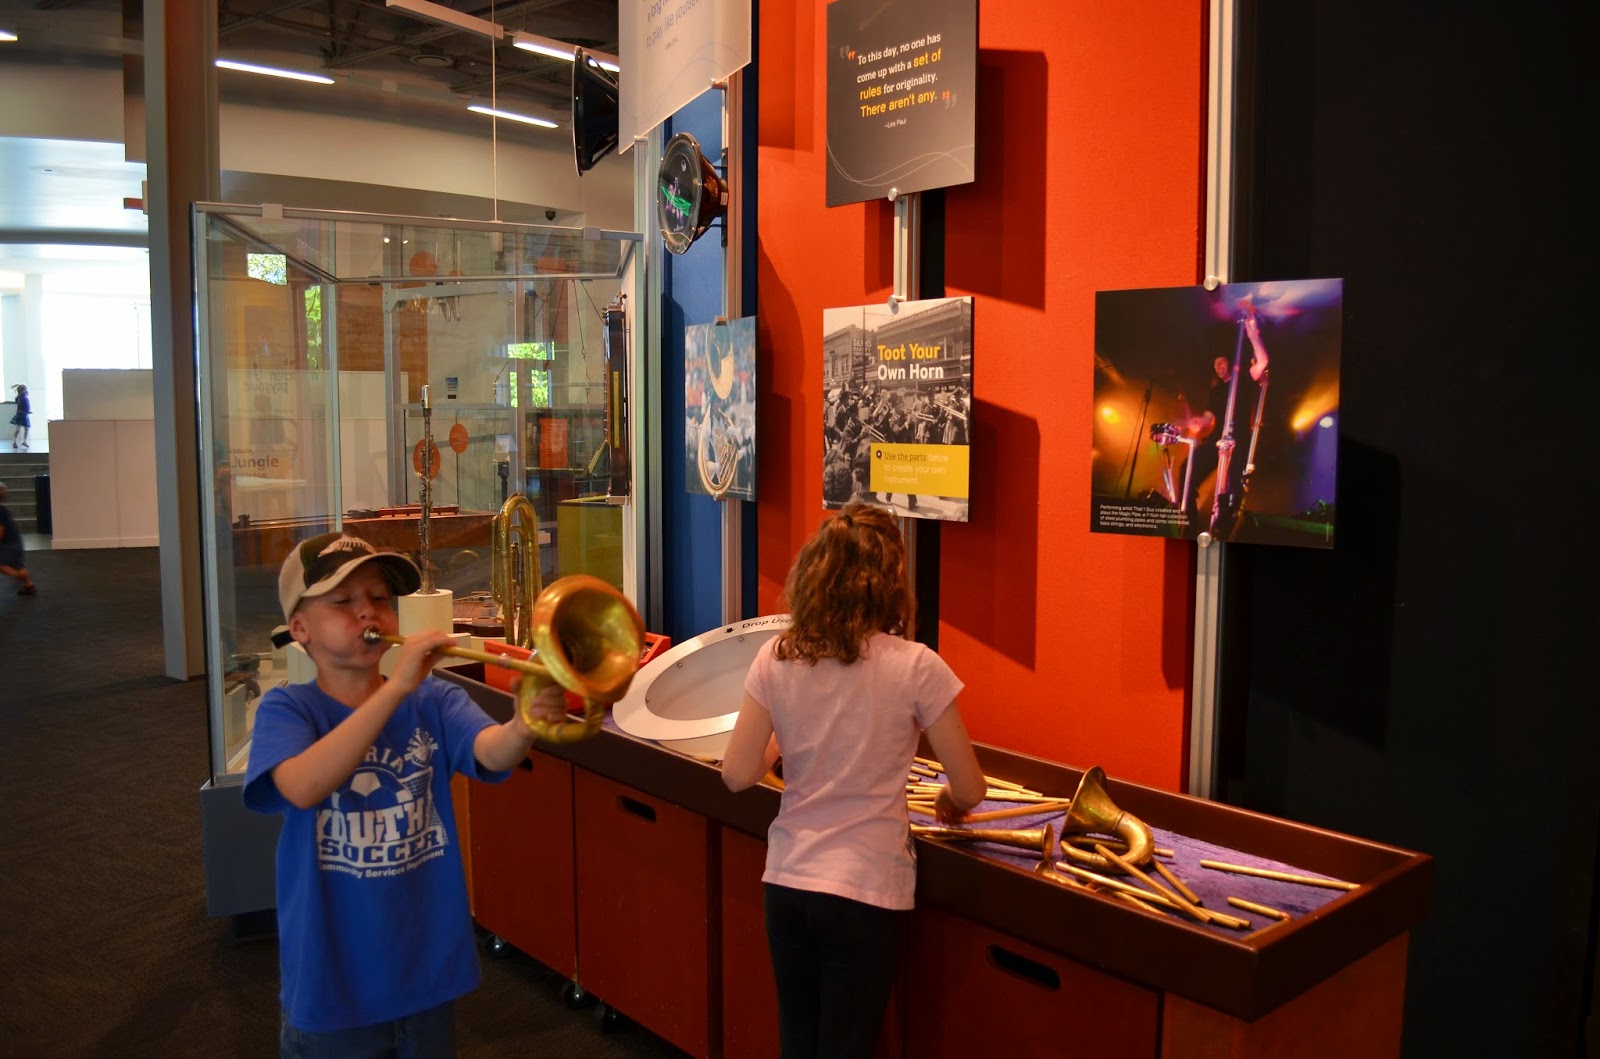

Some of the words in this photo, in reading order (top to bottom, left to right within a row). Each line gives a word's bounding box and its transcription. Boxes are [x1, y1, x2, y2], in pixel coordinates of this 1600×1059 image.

[664, 14, 674, 31] like
[858, 55, 867, 65] To
[868, 50, 882, 63] this
[883, 46, 899, 58] day,
[900, 43, 910, 53] no
[911, 38, 925, 50] one
[927, 33, 941, 45] has
[857, 71, 876, 83] come
[877, 68, 888, 79] up
[888, 61, 906, 75] with
[906, 62, 912, 70] a
[913, 53, 929, 68] set
[931, 48, 942, 63] of
[860, 86, 882, 100] rules
[883, 83, 895, 95] for
[896, 72, 938, 91] originality.
[861, 103, 886, 118] There
[889, 94, 915, 111] aren't
[918, 90, 938, 104] any.
[877, 344, 906, 361] Toot
[908, 343, 941, 360] Your
[877, 364, 906, 381] Own
[909, 363, 944, 380] Horn
[231, 455, 279, 470] Jungle
[884, 451, 897, 460] Use
[897, 452, 909, 461] the
[909, 453, 927, 463] parts
[927, 453, 949, 462] below
[892, 464, 913, 473] create
[914, 466, 930, 475] your
[931, 467, 947, 475] own
[742, 620, 769, 629] Drop
[317, 797, 425, 845] YOUTH
[320, 829, 440, 864] SOCCER
[365, 866, 405, 878] Services
[406, 848, 445, 870] Department
